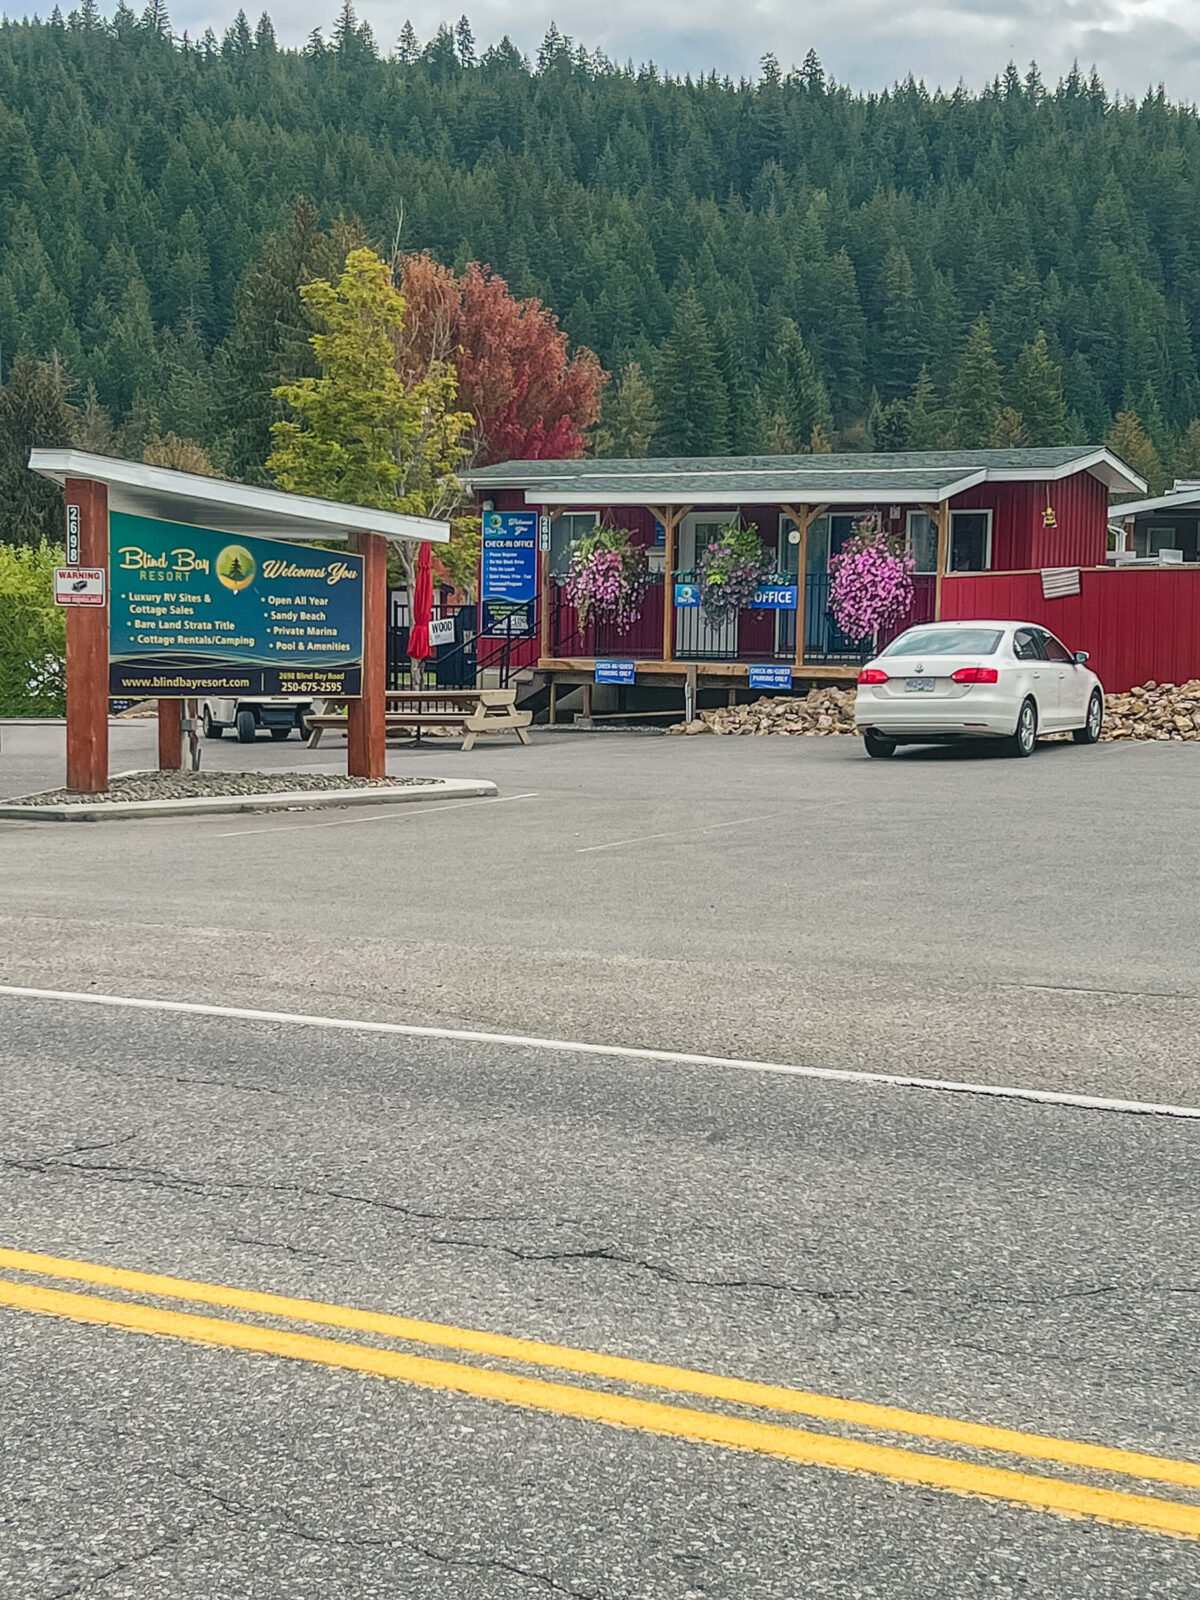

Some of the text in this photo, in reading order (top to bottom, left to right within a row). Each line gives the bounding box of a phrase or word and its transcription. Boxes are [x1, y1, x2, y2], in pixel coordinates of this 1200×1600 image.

[485, 540, 534, 548] CHECK-IN OFFICE
[118, 546, 209, 575] Blind Bay
[59, 571, 100, 579] WARNING
[140, 570, 190, 581] RESORT
[262, 560, 358, 585] Welcomes You
[128, 592, 211, 603] Luxury RV Sites &
[268, 595, 328, 606] Open All Year
[754, 591, 792, 604] OFFICE
[129, 604, 194, 616] Cottage Sales
[270, 611, 326, 622] Sandy Beach
[134, 619, 235, 630] Bare Land Strata Title
[431, 621, 452, 633] WOOD
[273, 626, 337, 636] Private Marina
[137, 634, 255, 647] Cottage Rentals/Camping
[276, 641, 350, 651] Pool & Amenities
[296, 672, 313, 680] Blind
[314, 672, 327, 681] Bay
[327, 672, 344, 680] Road
[122, 677, 250, 689] www.blindbayresort.com
[281, 682, 342, 692] 250-675-2595
